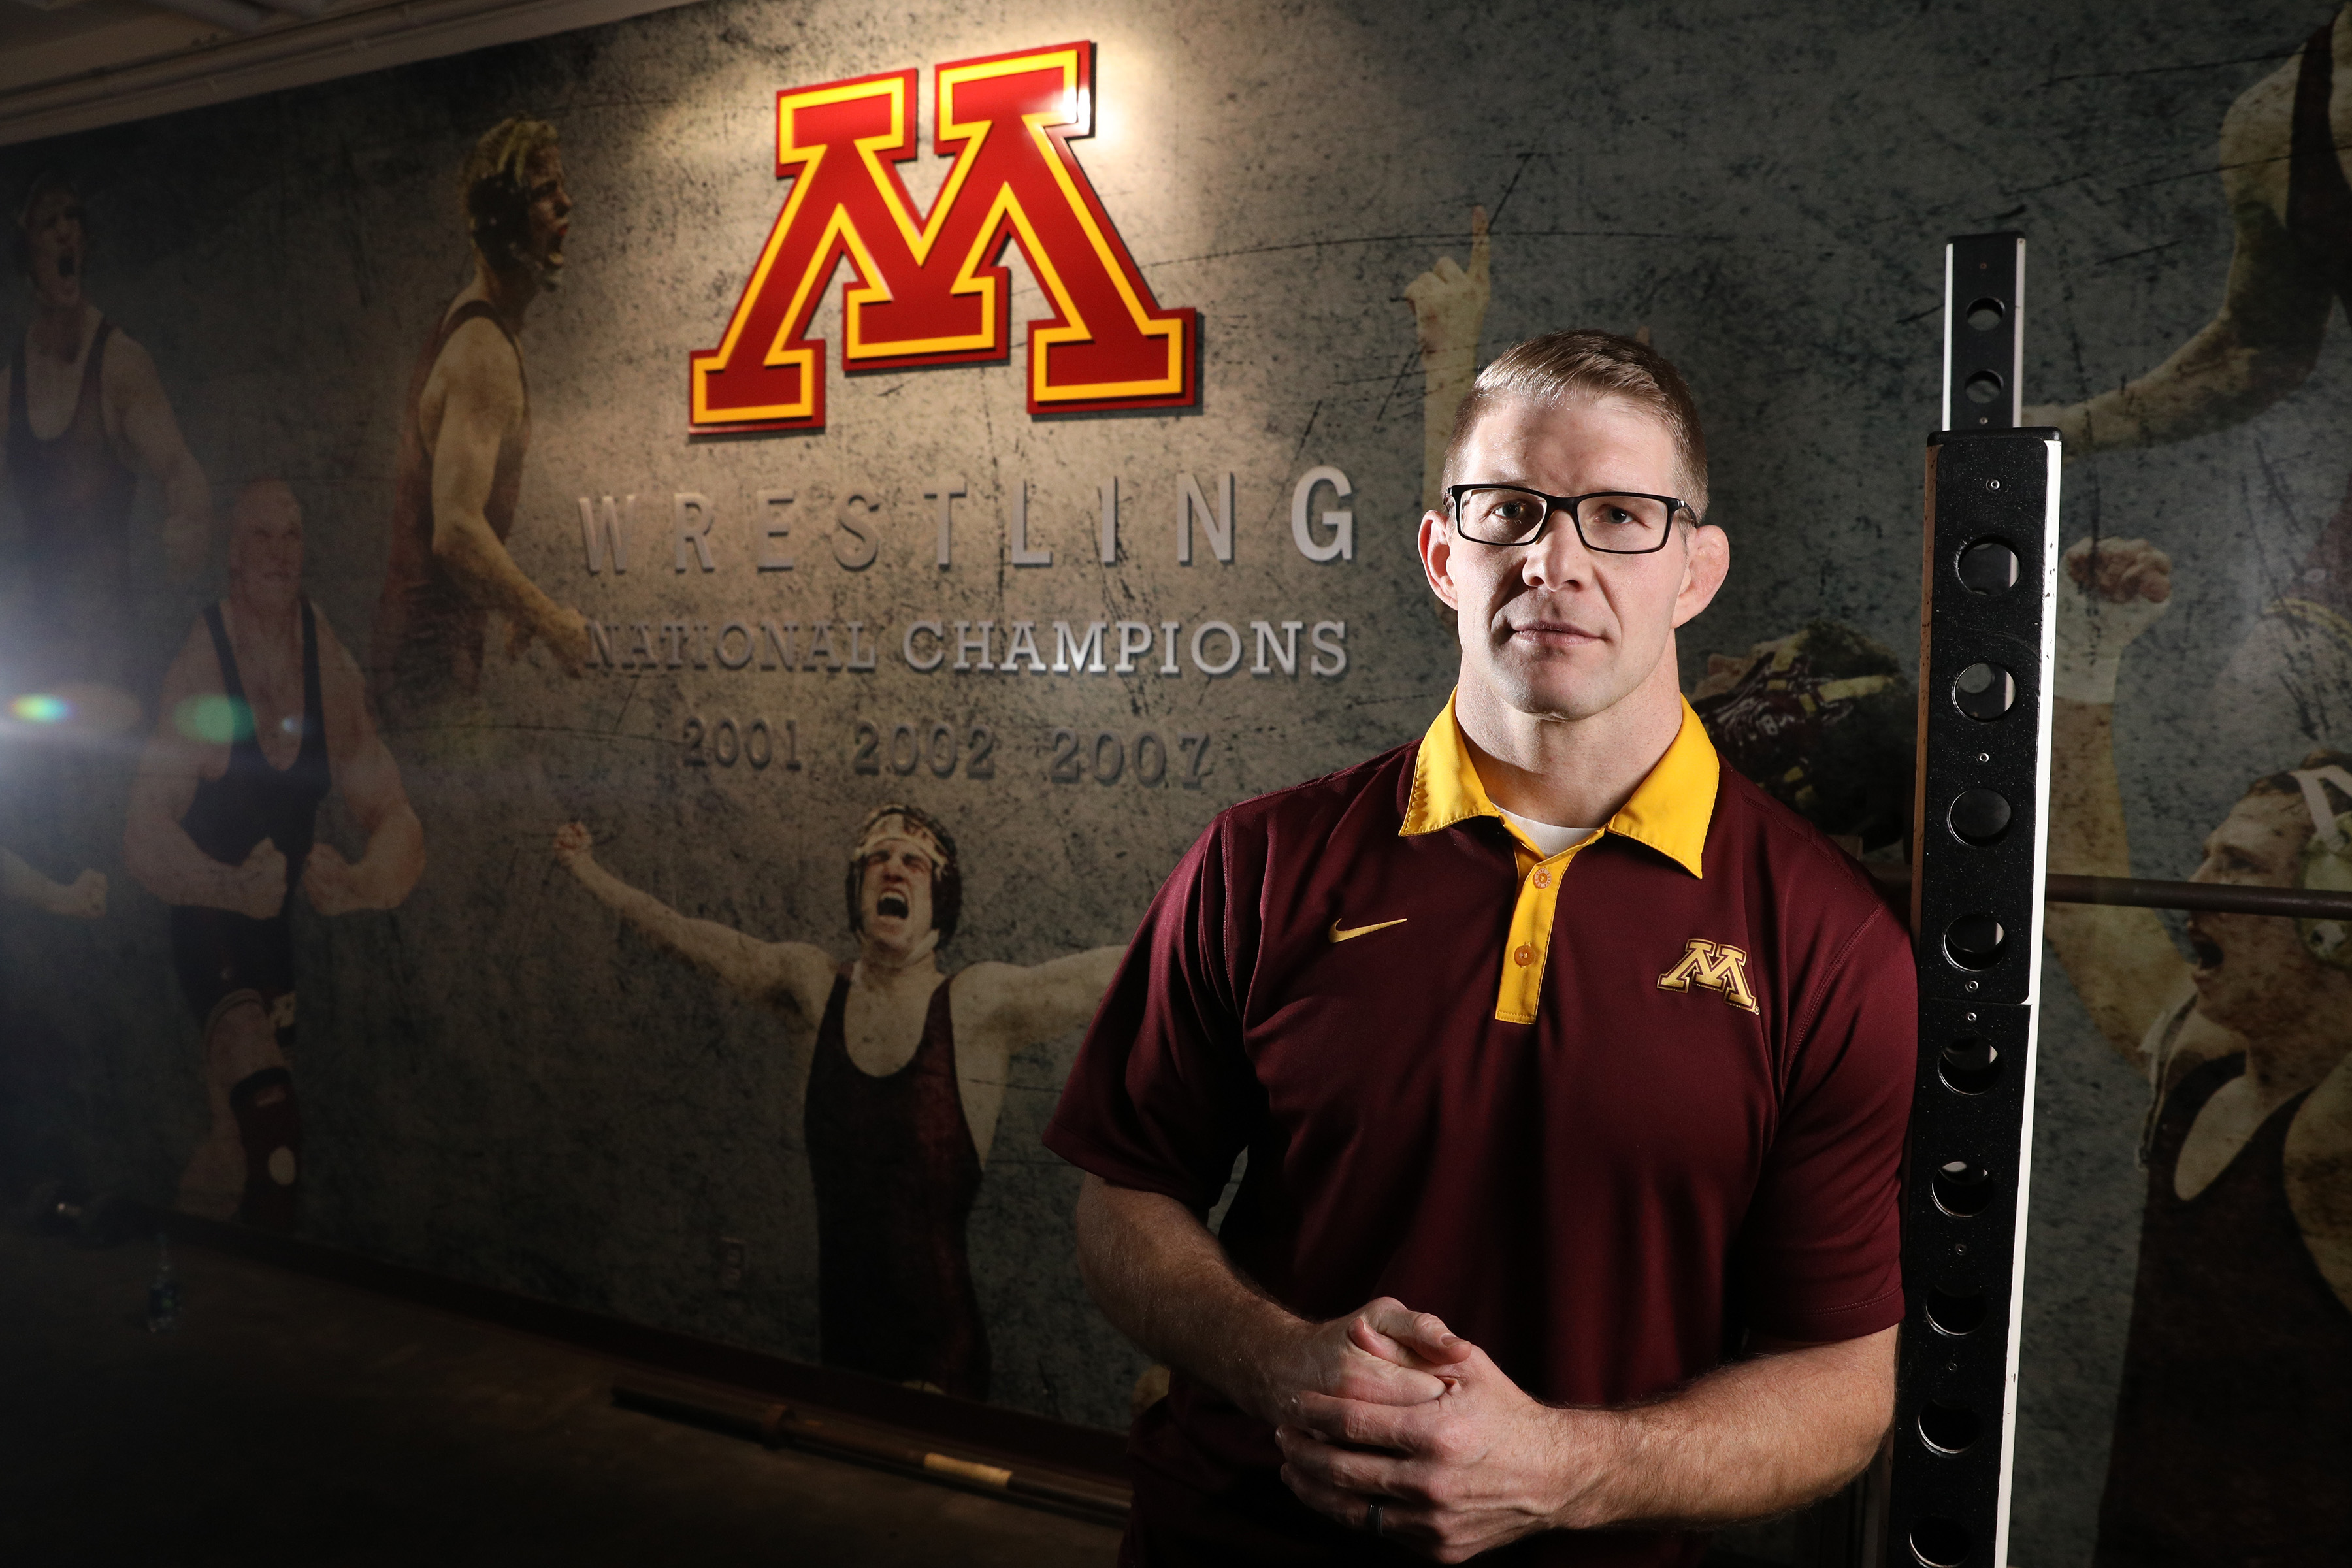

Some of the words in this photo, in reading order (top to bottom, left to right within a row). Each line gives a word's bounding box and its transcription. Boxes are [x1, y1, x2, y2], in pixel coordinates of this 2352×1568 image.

[689, 40, 1196, 434] M
[578, 465, 1353, 576] WRESTLING
[584, 620, 877, 673] NATIONAL
[903, 619, 1347, 677] CHAMPIONS
[683, 718, 802, 771] 2001
[854, 721, 996, 779] 2002
[1049, 727, 1211, 787] 2007
